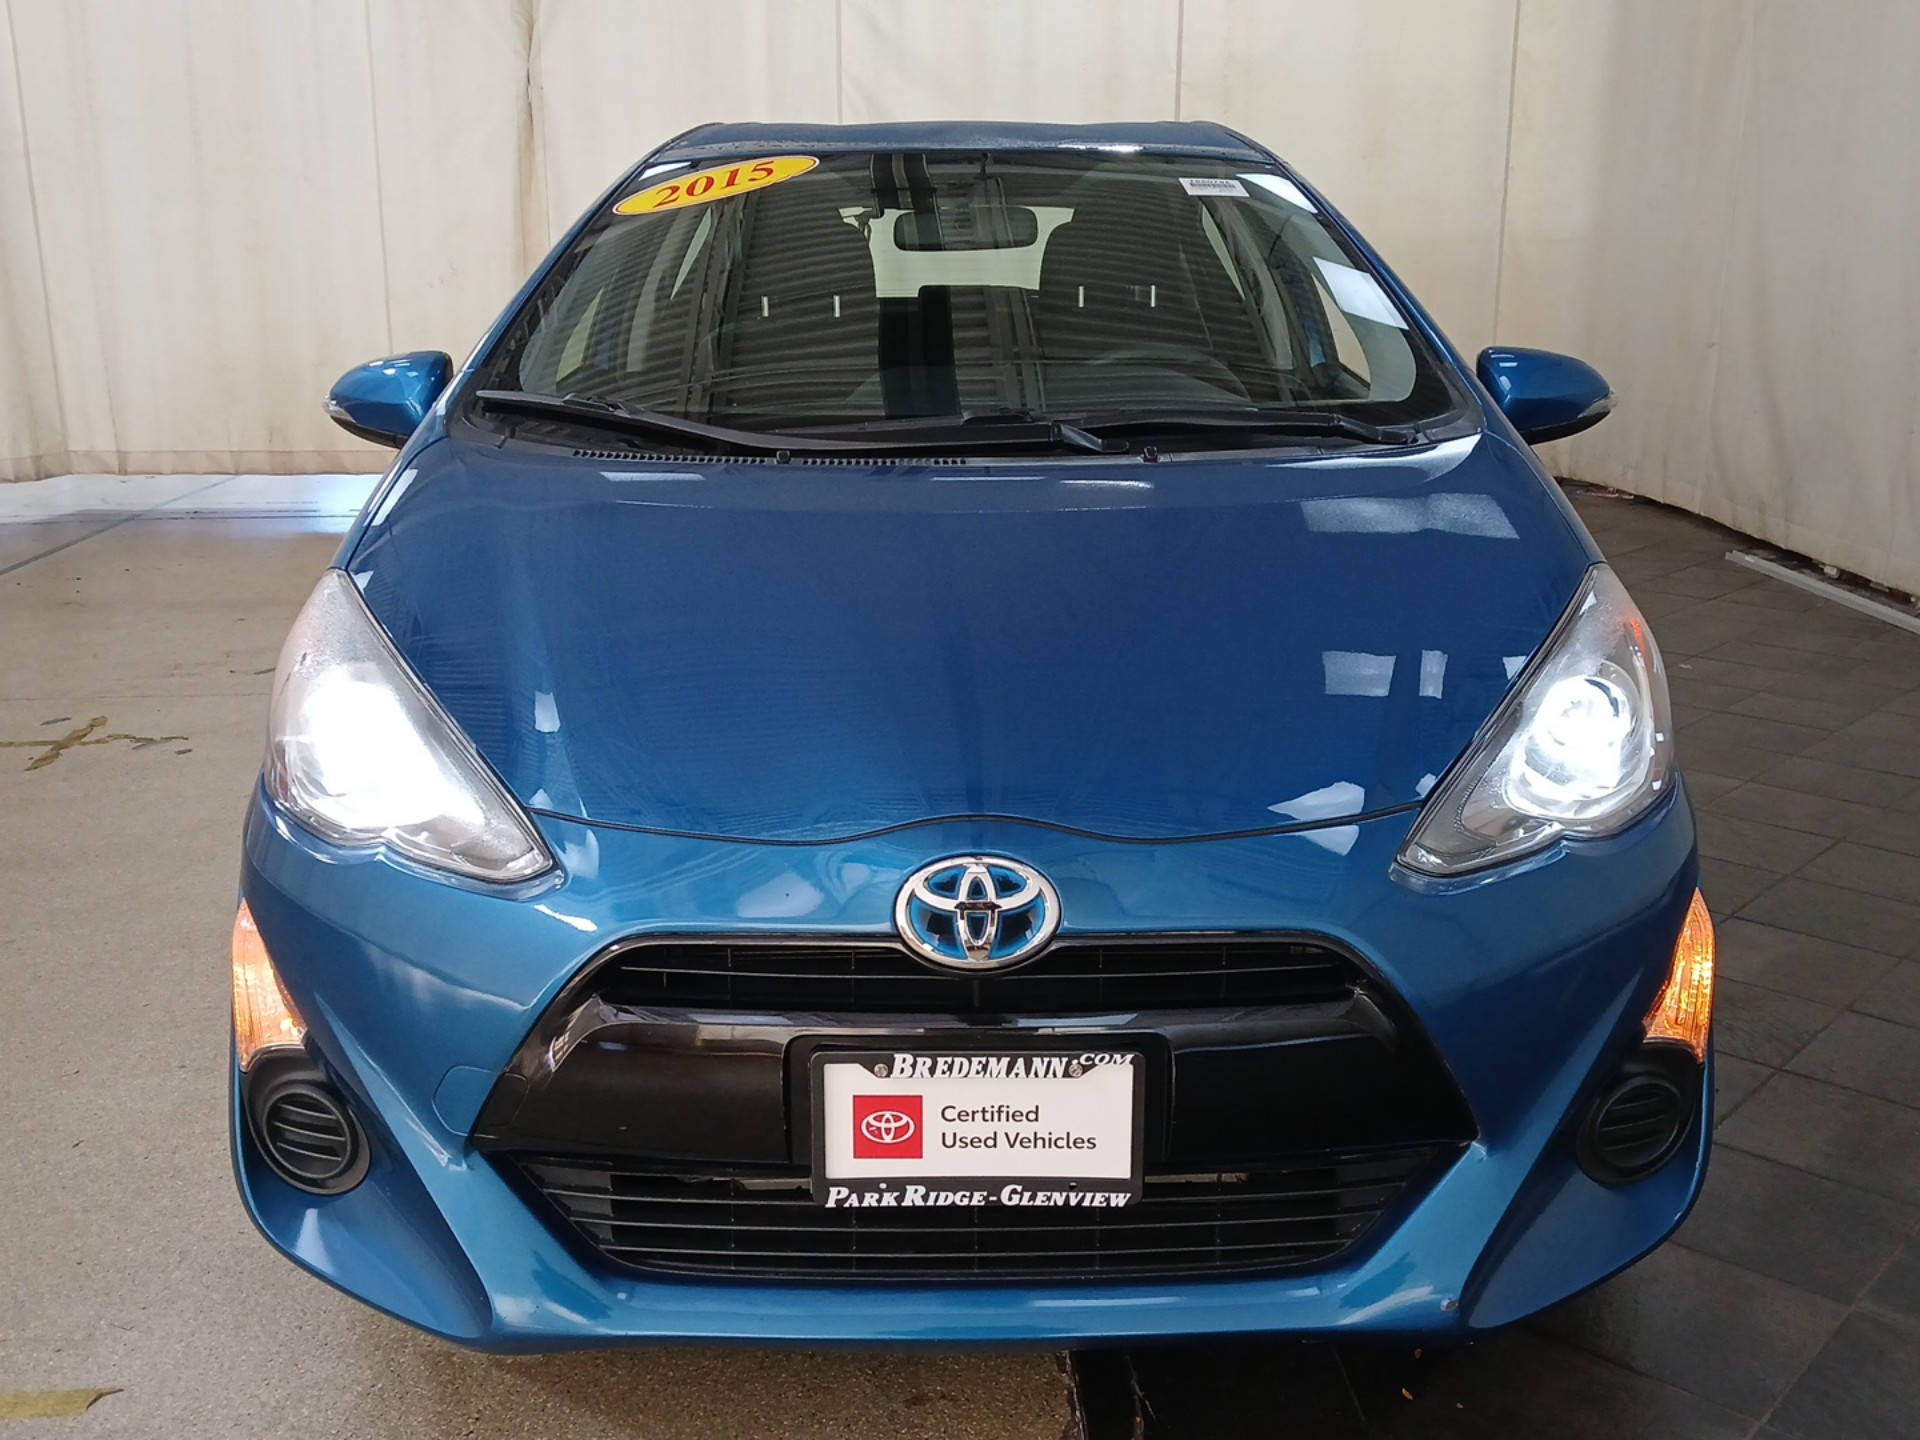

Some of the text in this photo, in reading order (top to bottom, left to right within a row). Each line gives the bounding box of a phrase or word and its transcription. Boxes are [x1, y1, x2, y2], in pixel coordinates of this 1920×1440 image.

[654, 160, 775, 207] 2015
[941, 1104, 1040, 1123] Certified
[941, 1132, 1097, 1150] Used Vehicles
